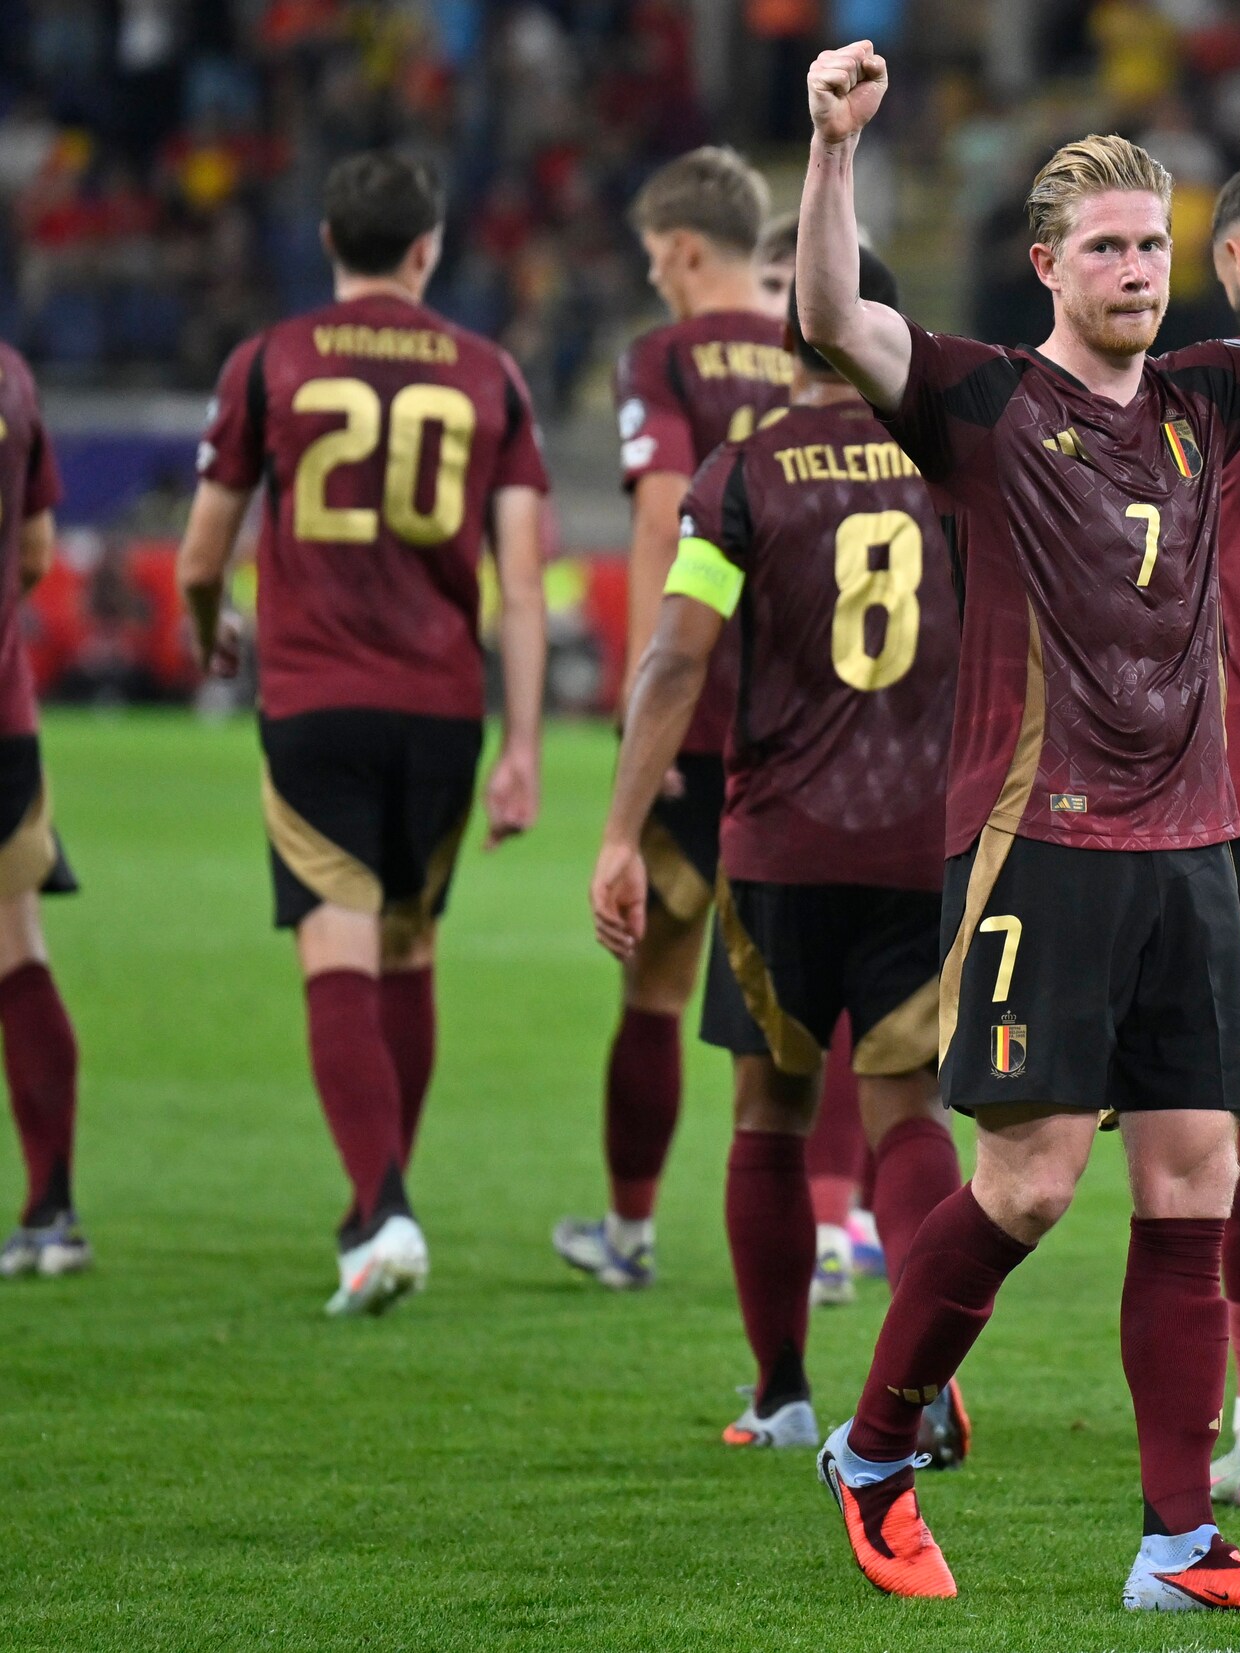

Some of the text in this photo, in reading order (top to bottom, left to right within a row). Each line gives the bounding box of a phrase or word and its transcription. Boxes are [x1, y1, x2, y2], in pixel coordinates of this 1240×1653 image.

[291, 376, 476, 546] 20
[831, 510, 922, 691] 8
[1125, 503, 1160, 586] 7
[979, 914, 1023, 1003] 7
